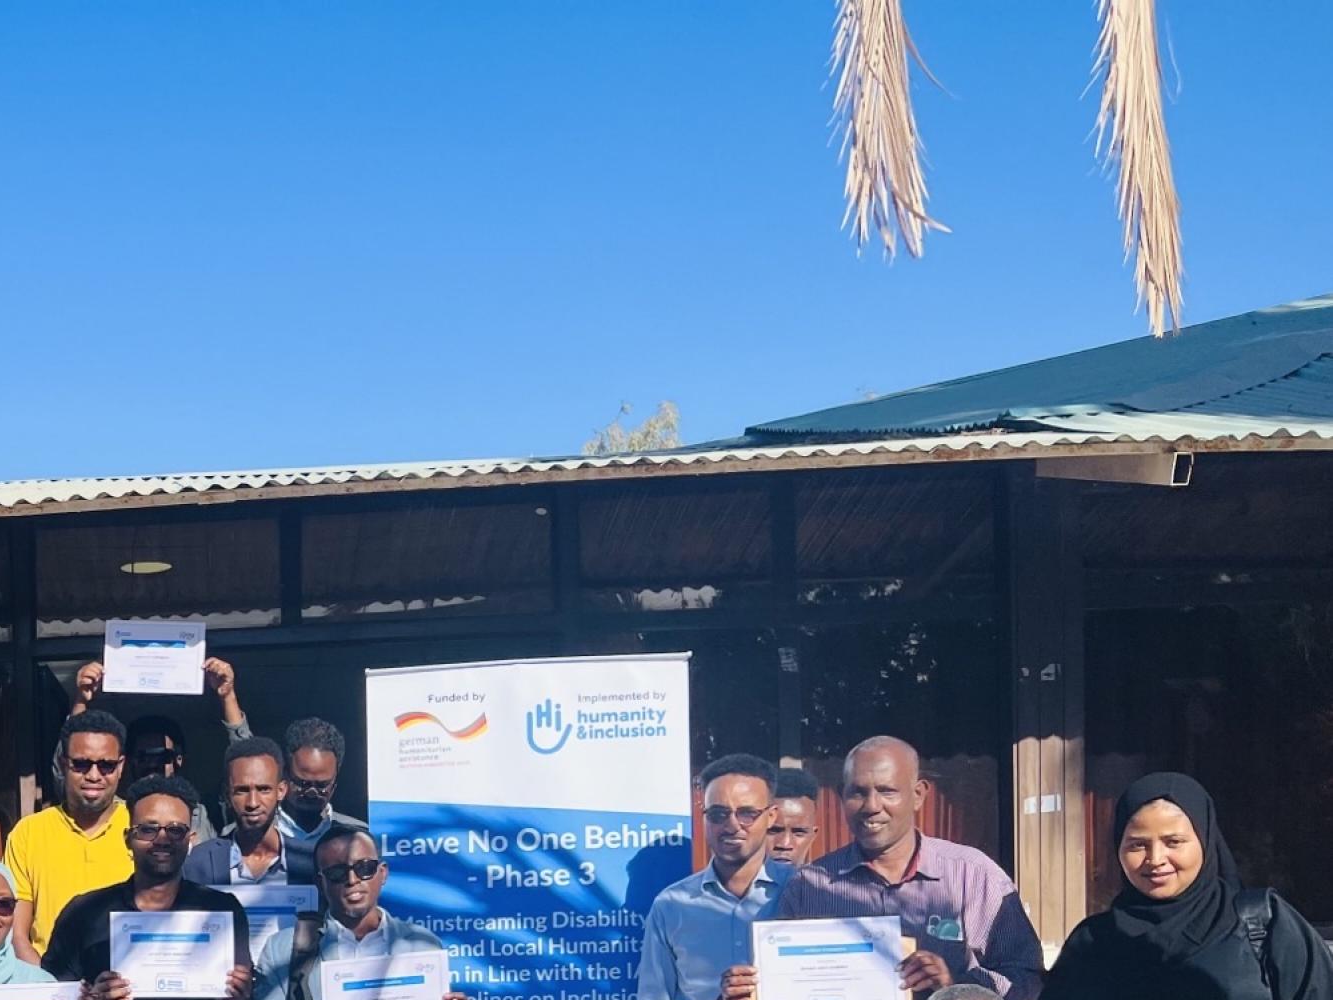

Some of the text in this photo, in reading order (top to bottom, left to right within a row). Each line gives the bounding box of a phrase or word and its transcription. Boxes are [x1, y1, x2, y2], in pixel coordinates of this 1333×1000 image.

[427, 692, 486, 703] Funded by
[577, 691, 666, 704] Implemented by
[577, 706, 666, 723] humanity
[576, 723, 666, 740] &inclusion
[381, 822, 683, 857] Leave No One Behind
[486, 864, 571, 889] Phase
[578, 861, 596, 886] 3
[552, 908, 647, 930] Disability
[448, 940, 485, 957] and
[490, 937, 543, 956] Local
[465, 966, 483, 983] in
[488, 965, 531, 983] Line
[535, 962, 582, 981] with
[586, 962, 622, 980] the
